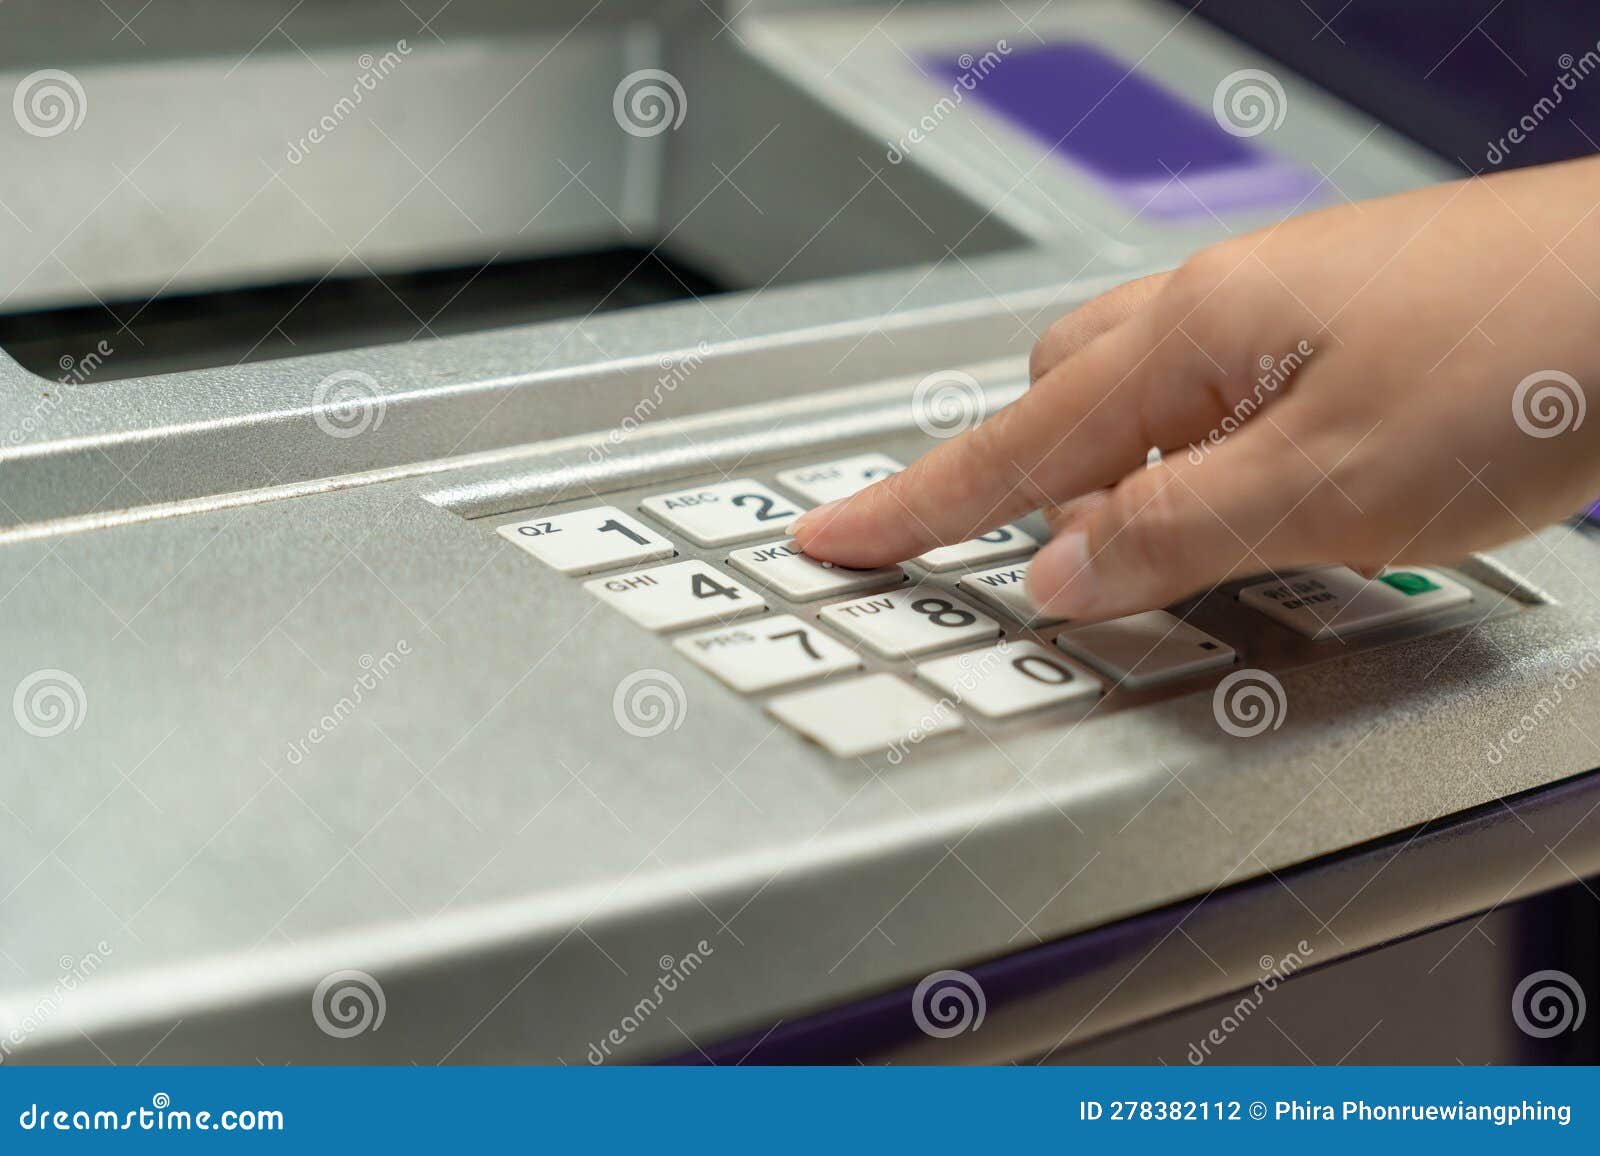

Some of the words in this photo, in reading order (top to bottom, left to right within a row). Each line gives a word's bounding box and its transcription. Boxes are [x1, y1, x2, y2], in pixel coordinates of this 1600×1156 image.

[663, 491, 722, 510] ABC
[731, 493, 795, 522] 2
[517, 521, 563, 539] QZ
[597, 518, 652, 547] 1
[604, 574, 660, 593] GHI
[690, 572, 742, 602] 4
[837, 597, 896, 618] TUV
[910, 598, 977, 628] 8
[766, 628, 824, 661] 7
[1011, 655, 1076, 685] 0
